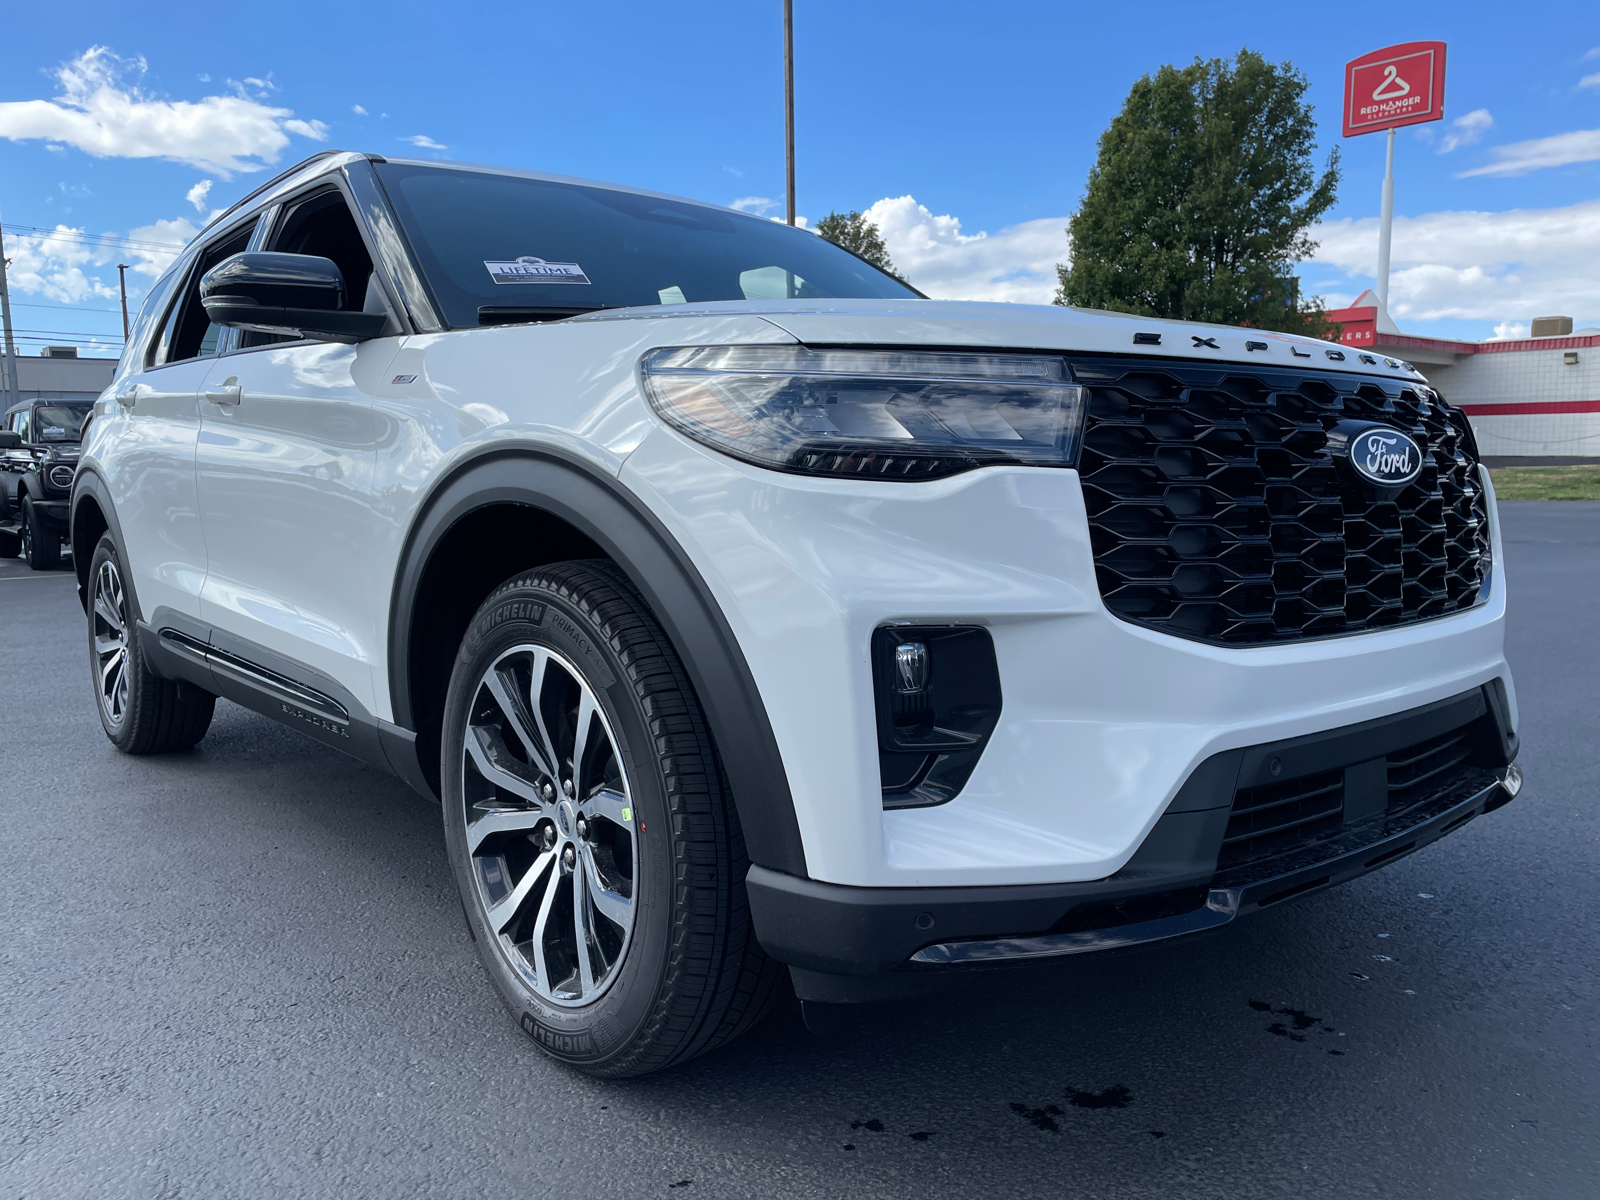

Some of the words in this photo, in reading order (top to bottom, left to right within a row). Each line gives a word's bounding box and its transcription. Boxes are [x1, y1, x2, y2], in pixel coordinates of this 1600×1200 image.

[1360, 105, 1378, 115] RED
[1380, 95, 1421, 111] HANGER
[1367, 106, 1412, 120] CLEANERS
[499, 266, 573, 275] LIFETIME
[1132, 332, 1417, 372] EXPLORER
[1365, 435, 1412, 475] Ford
[482, 603, 543, 633] MICHELIN
[551, 613, 594, 656] PRIMACY
[280, 703, 350, 738] EXPLORER
[524, 1016, 593, 1053] MICHELIN
